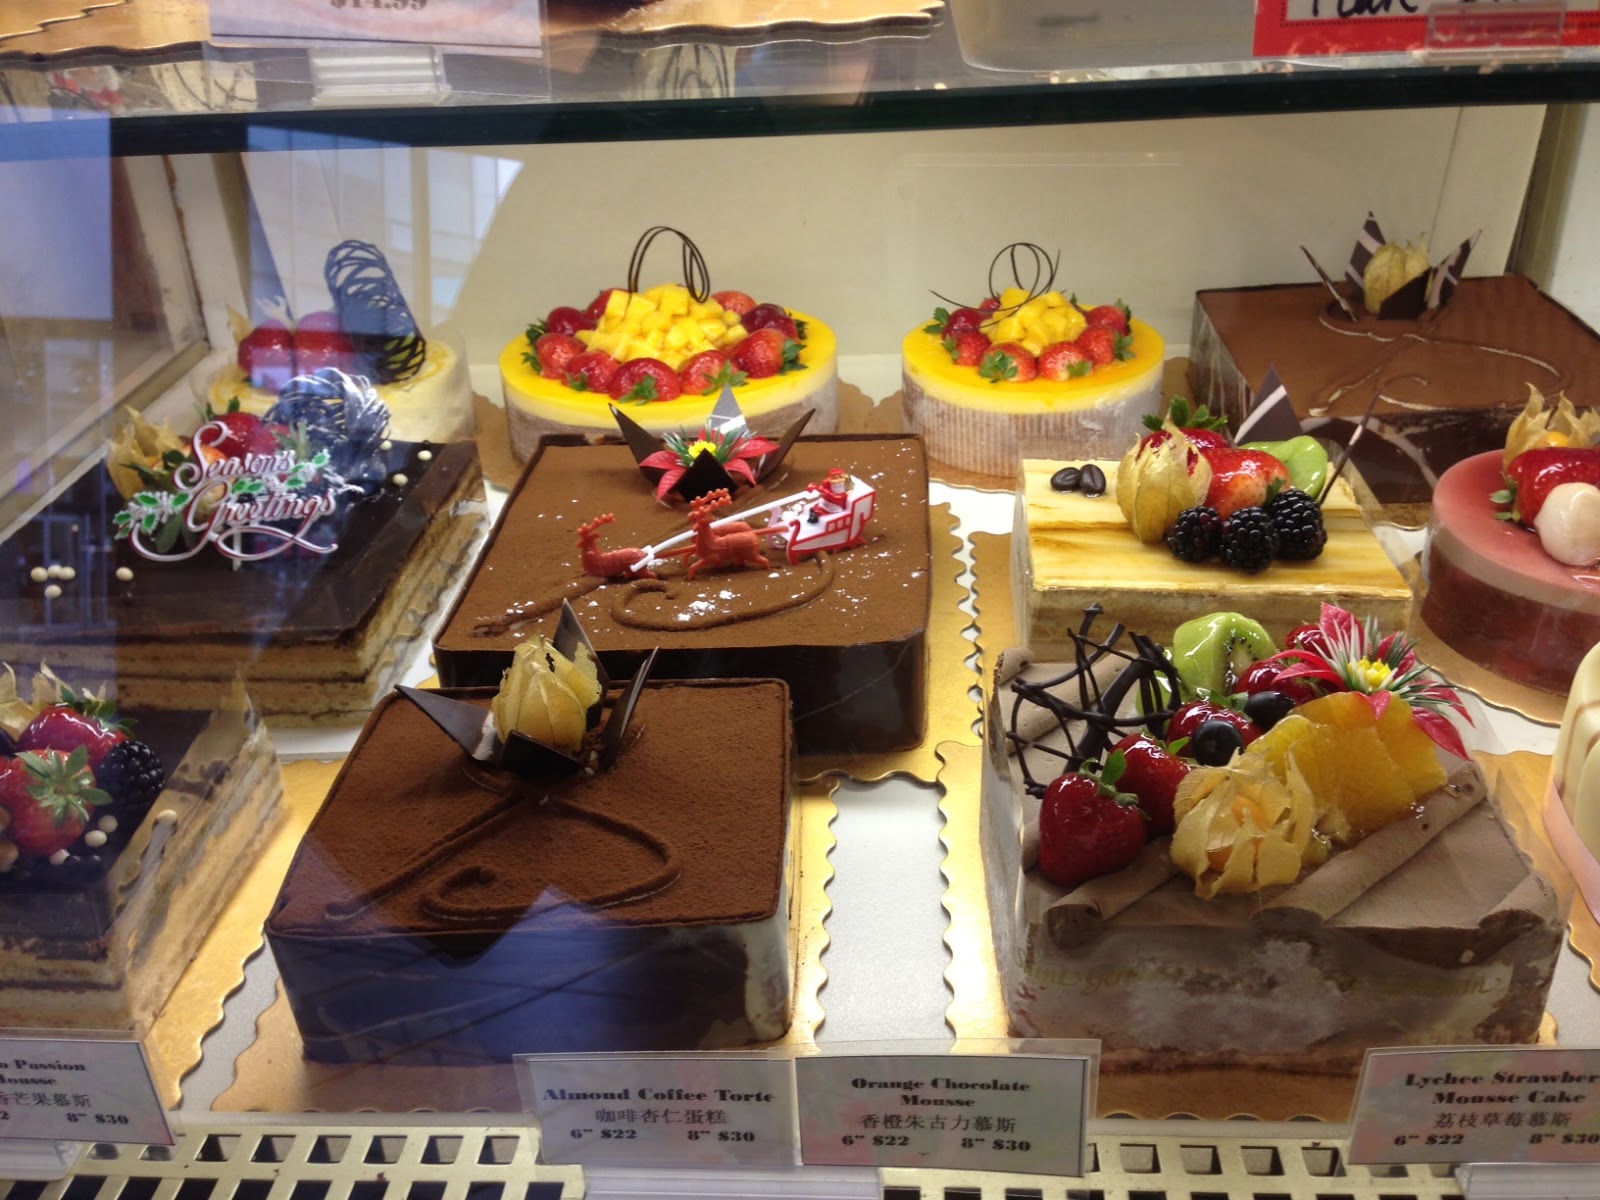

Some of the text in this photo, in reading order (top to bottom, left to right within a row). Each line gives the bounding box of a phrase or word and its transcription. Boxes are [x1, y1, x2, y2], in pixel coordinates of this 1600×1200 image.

[129, 478, 338, 562] Greetings
[14, 1058, 86, 1071] Passion
[851, 1077, 1031, 1092] Orange Chocolate
[1405, 1072, 1484, 1088] Lychee
[542, 1088, 776, 1103] Almond Coffee Torte
[900, 1095, 975, 1107] Mousse
[1433, 1090, 1586, 1105] Mousse Cake
[95, 1114, 129, 1125] $30
[595, 1108, 727, 1125] 咖啡杏仁蛋糕
[859, 1114, 1017, 1134] 香橙朱古力慕斯
[1433, 1112, 1573, 1128] 荔枝草莓慕斯
[600, 1128, 637, 1140] $22
[717, 1130, 755, 1143] $30
[1425, 1133, 1465, 1145] $22
[1561, 1133, 1600, 1145] $30
[872, 1135, 910, 1147] $22
[992, 1139, 1031, 1152] $30
